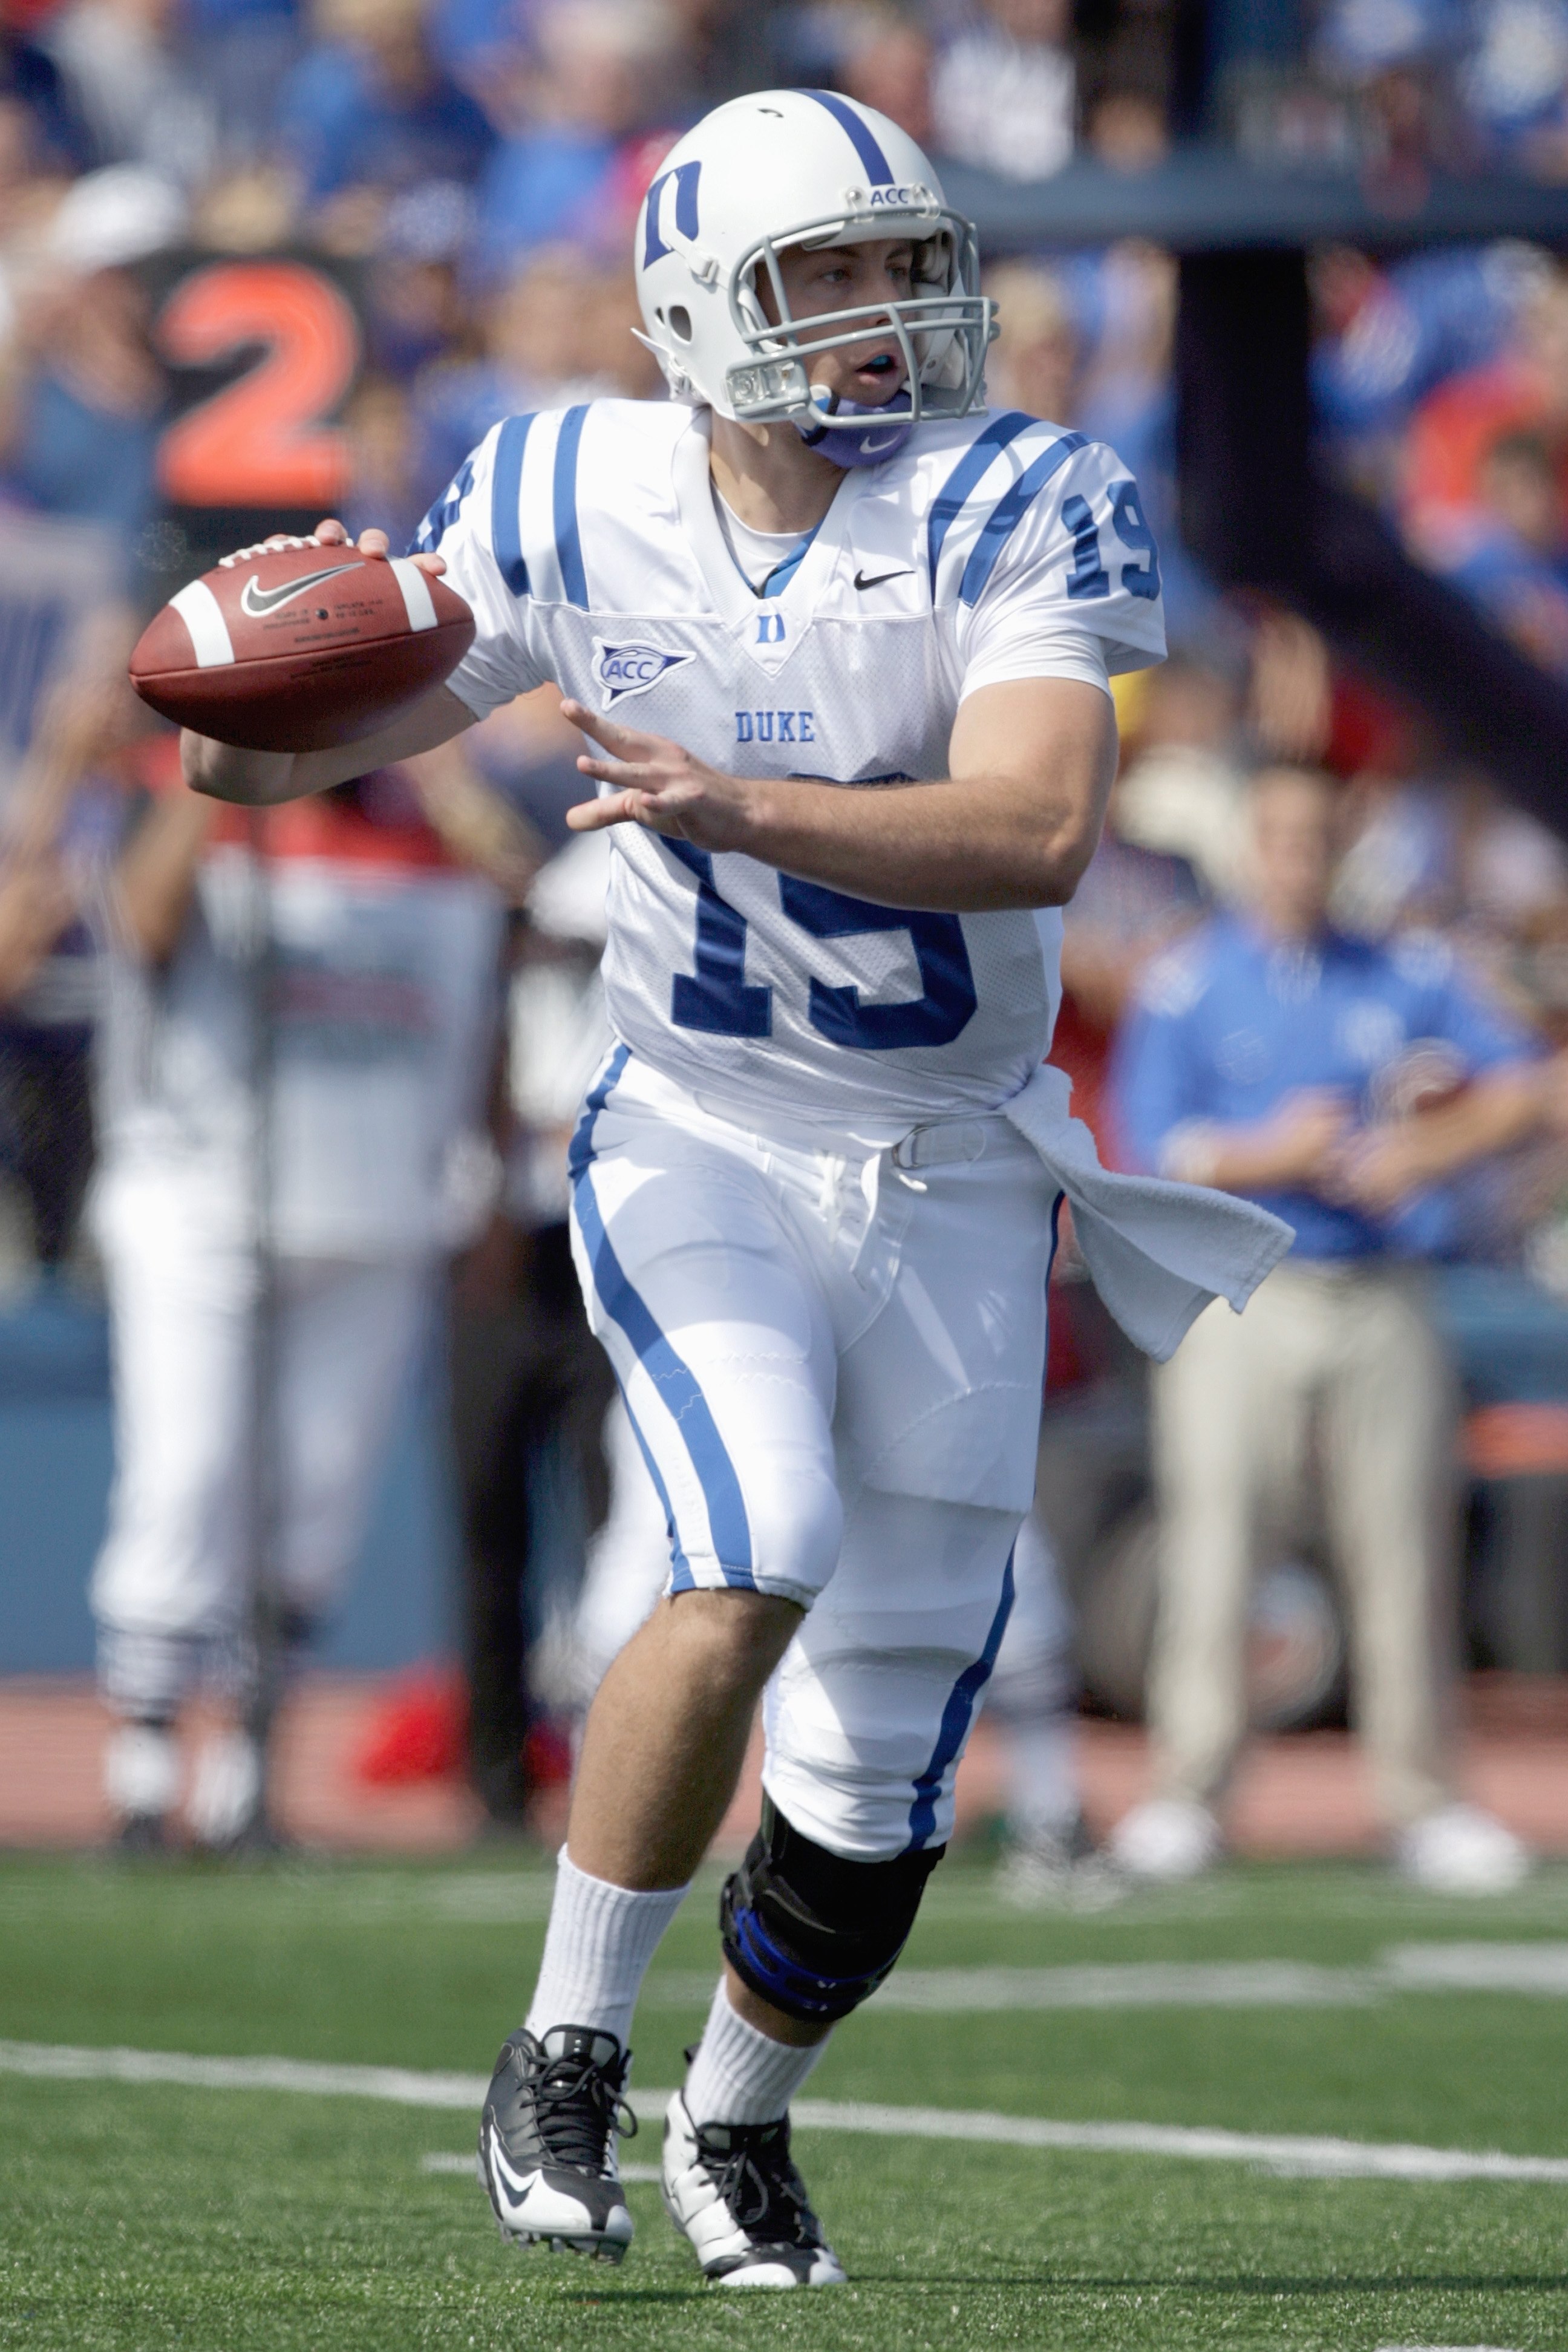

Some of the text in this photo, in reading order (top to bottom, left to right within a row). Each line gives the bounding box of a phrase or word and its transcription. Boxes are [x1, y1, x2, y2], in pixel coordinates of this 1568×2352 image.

[870, 188, 910, 206] ACC
[160, 261, 357, 507] 2
[1061, 480, 1161, 601] 19
[755, 613, 785, 644] D
[605, 659, 653, 680] ACC
[735, 711, 815, 743] DUKE
